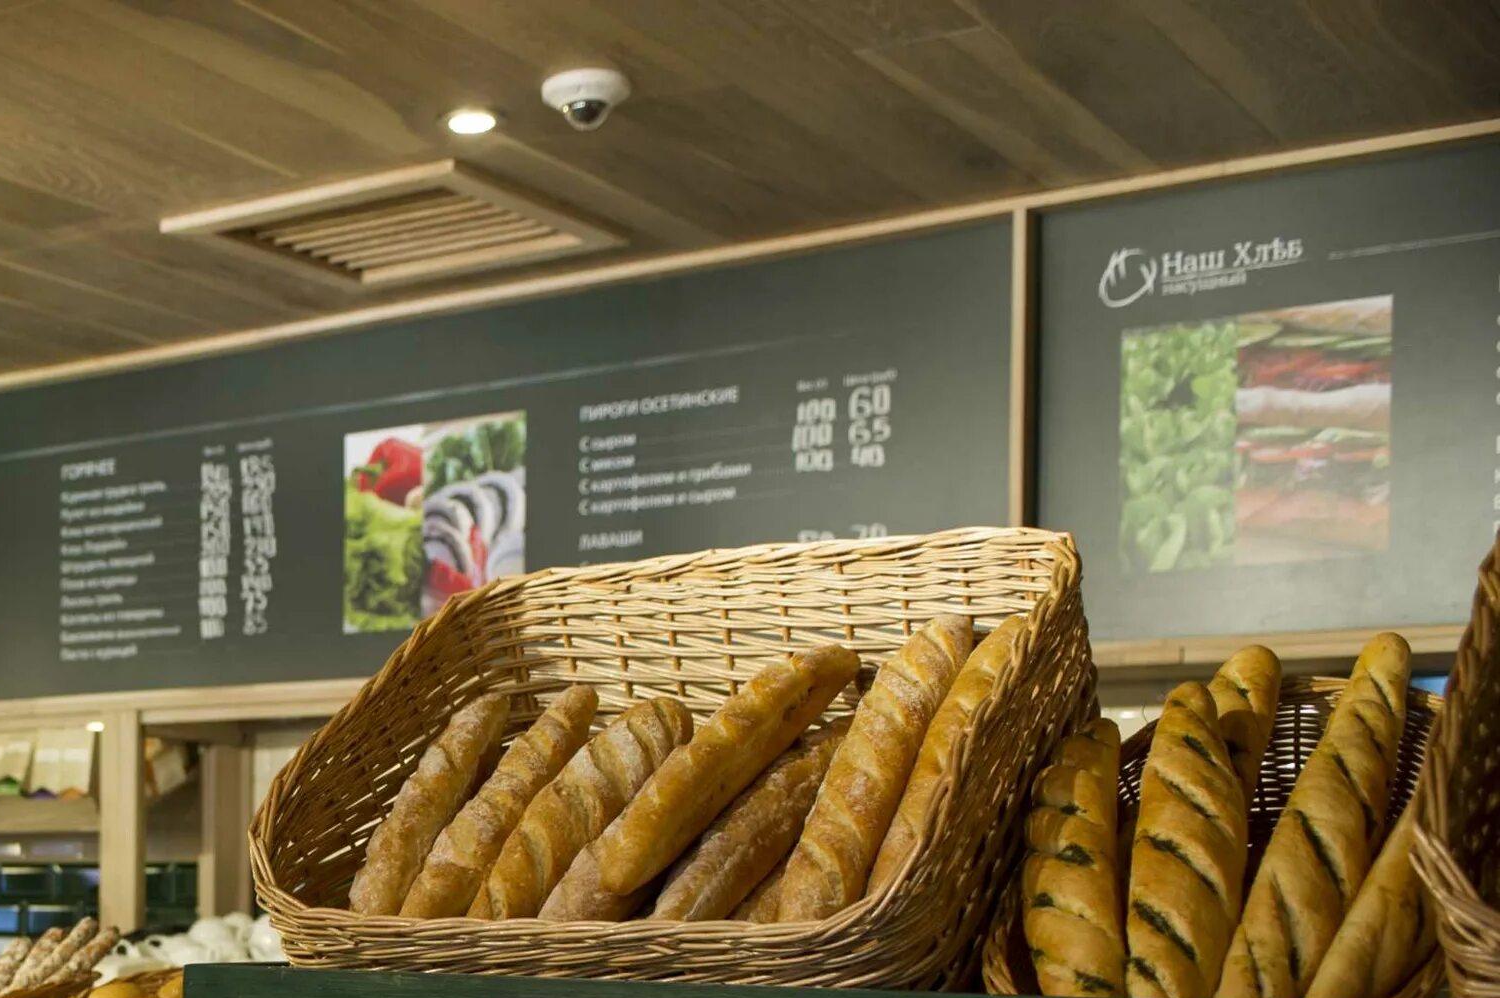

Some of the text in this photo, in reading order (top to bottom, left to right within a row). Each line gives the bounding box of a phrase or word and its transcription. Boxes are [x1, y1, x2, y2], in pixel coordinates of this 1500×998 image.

[1161, 250, 1225, 278] Наш
[579, 385, 739, 423] ПИРОГИ ОСЕТИНСКИЕ
[848, 383, 892, 420] 60
[848, 415, 892, 446] 65
